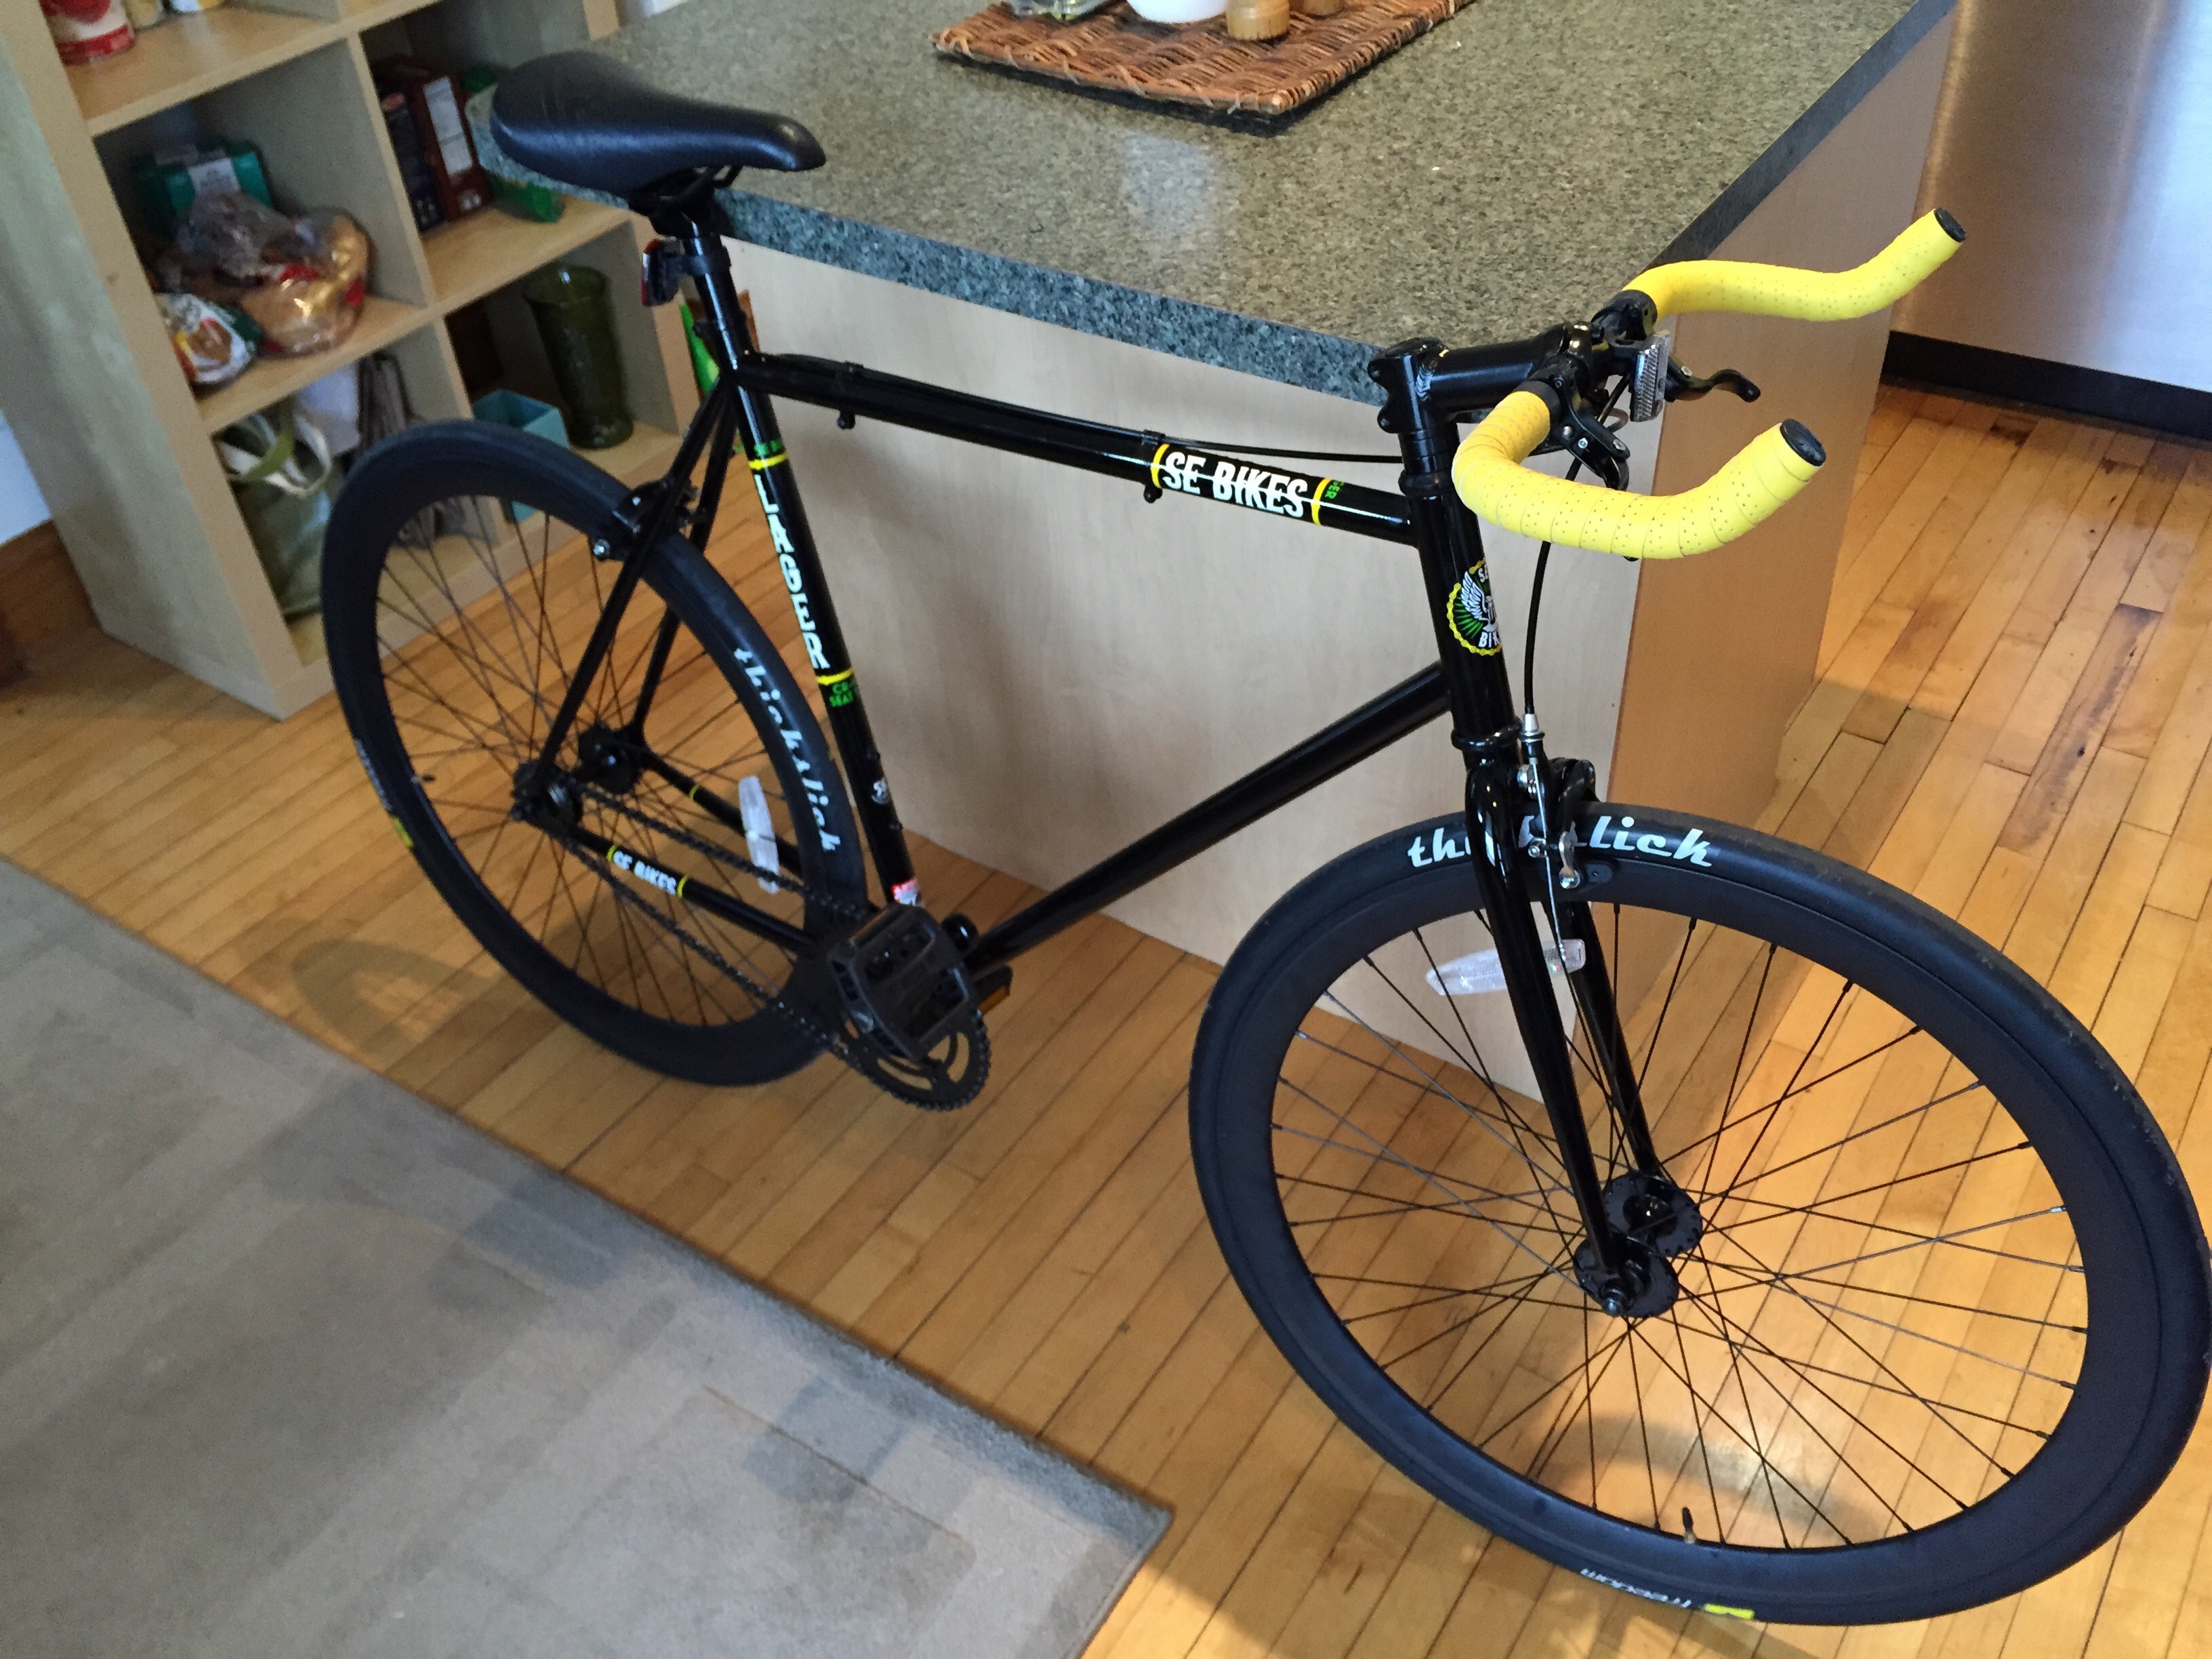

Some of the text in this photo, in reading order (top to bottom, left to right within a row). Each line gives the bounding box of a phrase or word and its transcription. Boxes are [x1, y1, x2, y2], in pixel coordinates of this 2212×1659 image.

[1162, 451, 1308, 518] SE BIKES
[754, 474, 831, 670] LAGER
